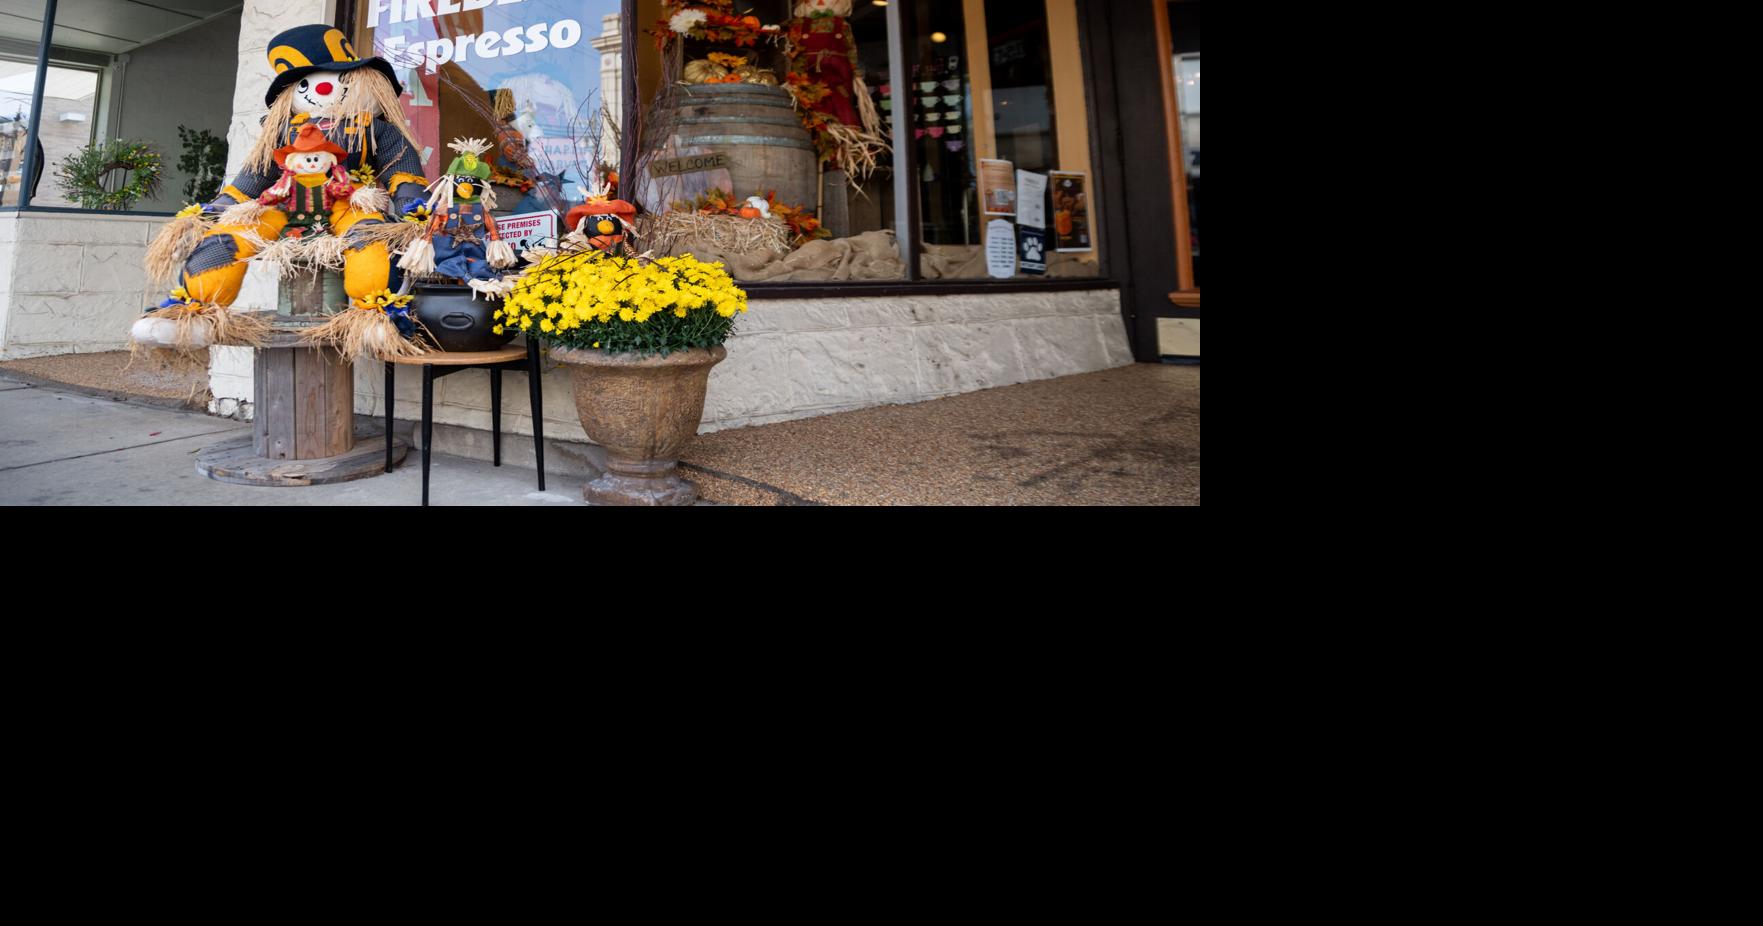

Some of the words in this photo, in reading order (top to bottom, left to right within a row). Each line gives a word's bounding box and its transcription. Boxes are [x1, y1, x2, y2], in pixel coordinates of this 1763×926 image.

[384, 18, 582, 76] Espresso
[653, 154, 725, 173] WELCOME
[507, 219, 541, 230] PREMISES
[523, 229, 533, 237] BY
